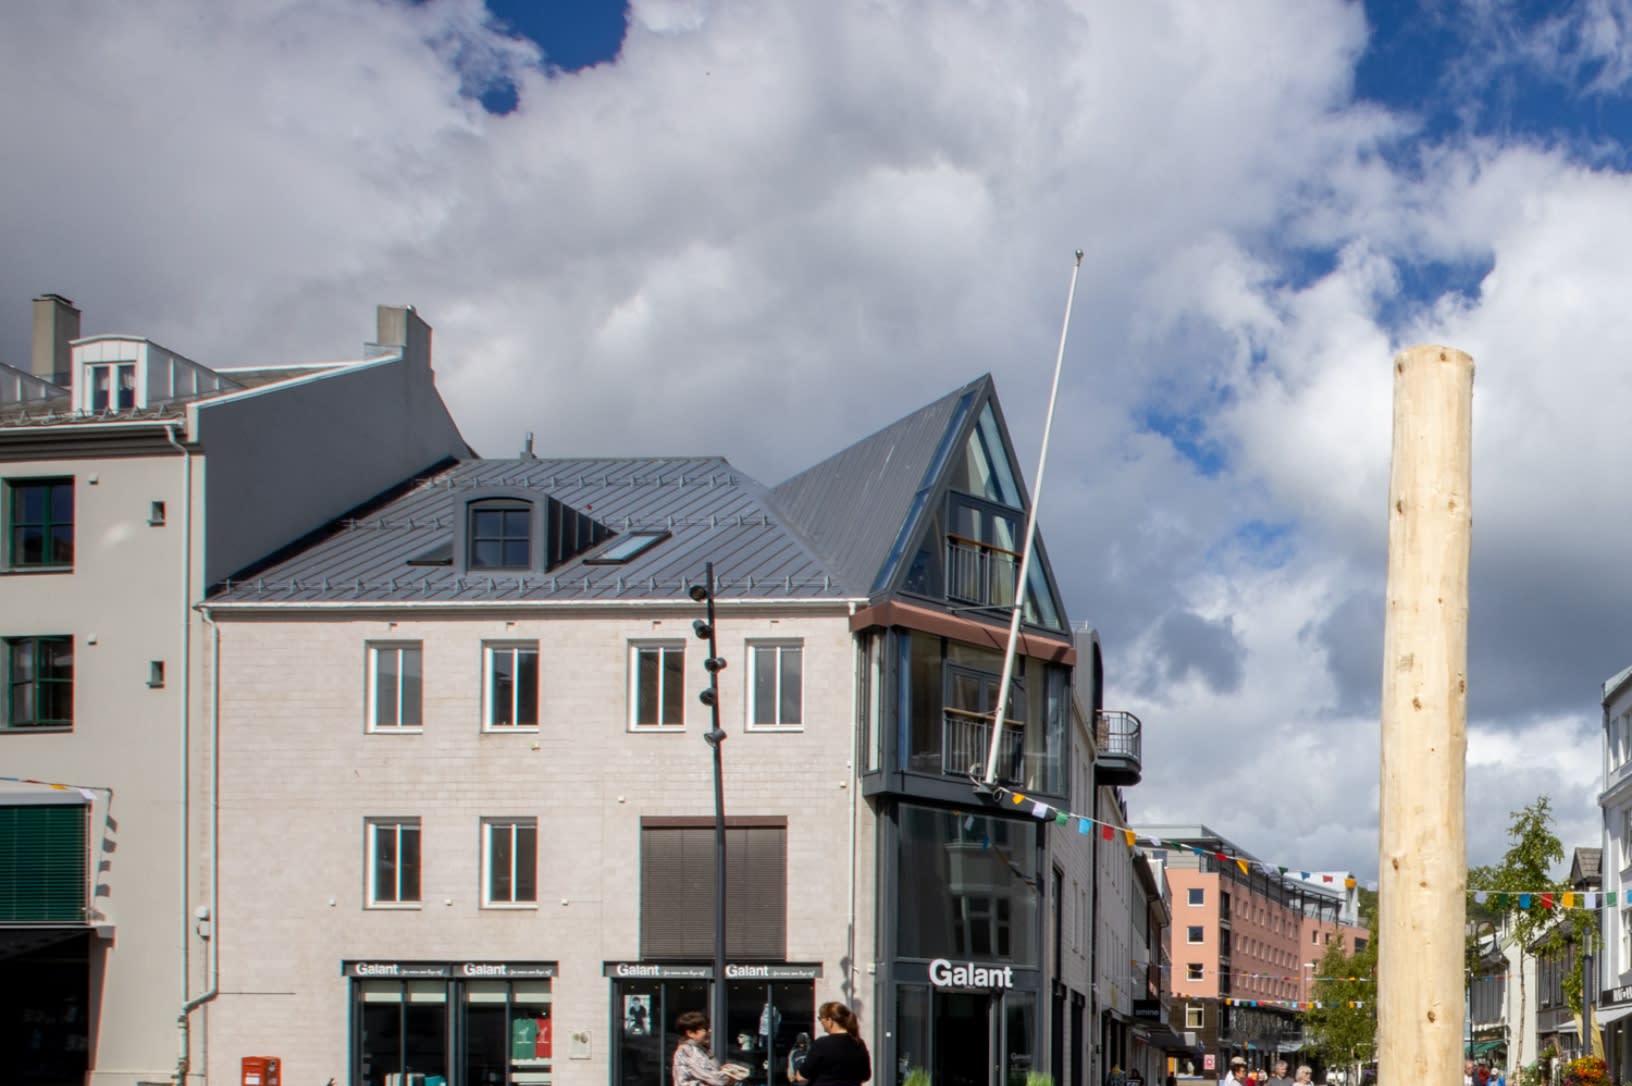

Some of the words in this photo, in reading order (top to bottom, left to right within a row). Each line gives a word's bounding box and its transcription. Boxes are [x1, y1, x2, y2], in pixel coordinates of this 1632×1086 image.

[356, 963, 399, 976] Galant
[464, 963, 507, 976] Galant
[616, 963, 660, 977] Galant
[725, 964, 769, 977] Galant
[928, 958, 1014, 988] Galant
